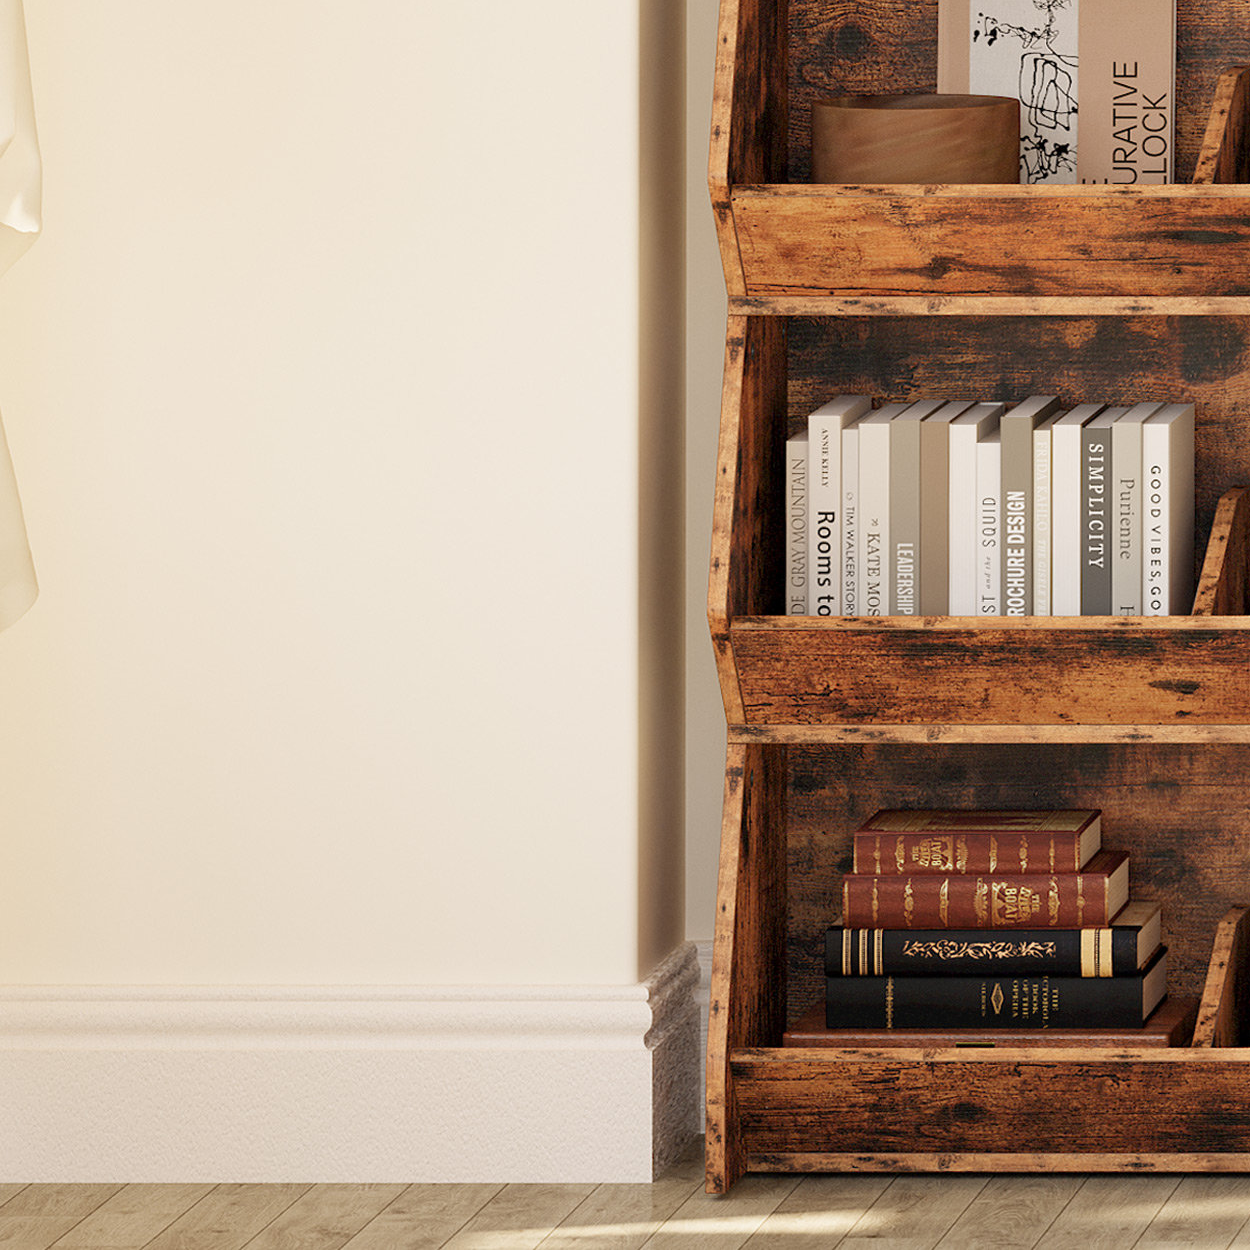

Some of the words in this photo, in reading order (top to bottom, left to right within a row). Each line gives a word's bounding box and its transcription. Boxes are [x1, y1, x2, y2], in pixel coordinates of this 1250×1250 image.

[1142, 93, 1168, 184] LOCK
[1037, 441, 1048, 481] FRIDA
[791, 458, 806, 545] MOUNTAIN
[1037, 485, 1048, 532] KAHLO
[1088, 443, 1104, 569] SIMPLICITY
[1150, 465, 1162, 518] GOOD
[846, 506, 855, 527] TIM
[982, 497, 996, 548] SQUID
[1007, 491, 1025, 544] DESIGN
[1120, 479, 1135, 560] Purienne
[791, 549, 806, 588] GRAY
[817, 511, 836, 587] Rooms
[846, 530, 855, 578] WALKER
[866, 532, 881, 577] KATE
[846, 580, 855, 616] STORY
[896, 543, 914, 615] LEADERSHIP
[1007, 547, 1025, 616] ROCHURE
[791, 595, 806, 614] DE
[817, 594, 835, 616] to
[982, 595, 996, 613] ST
